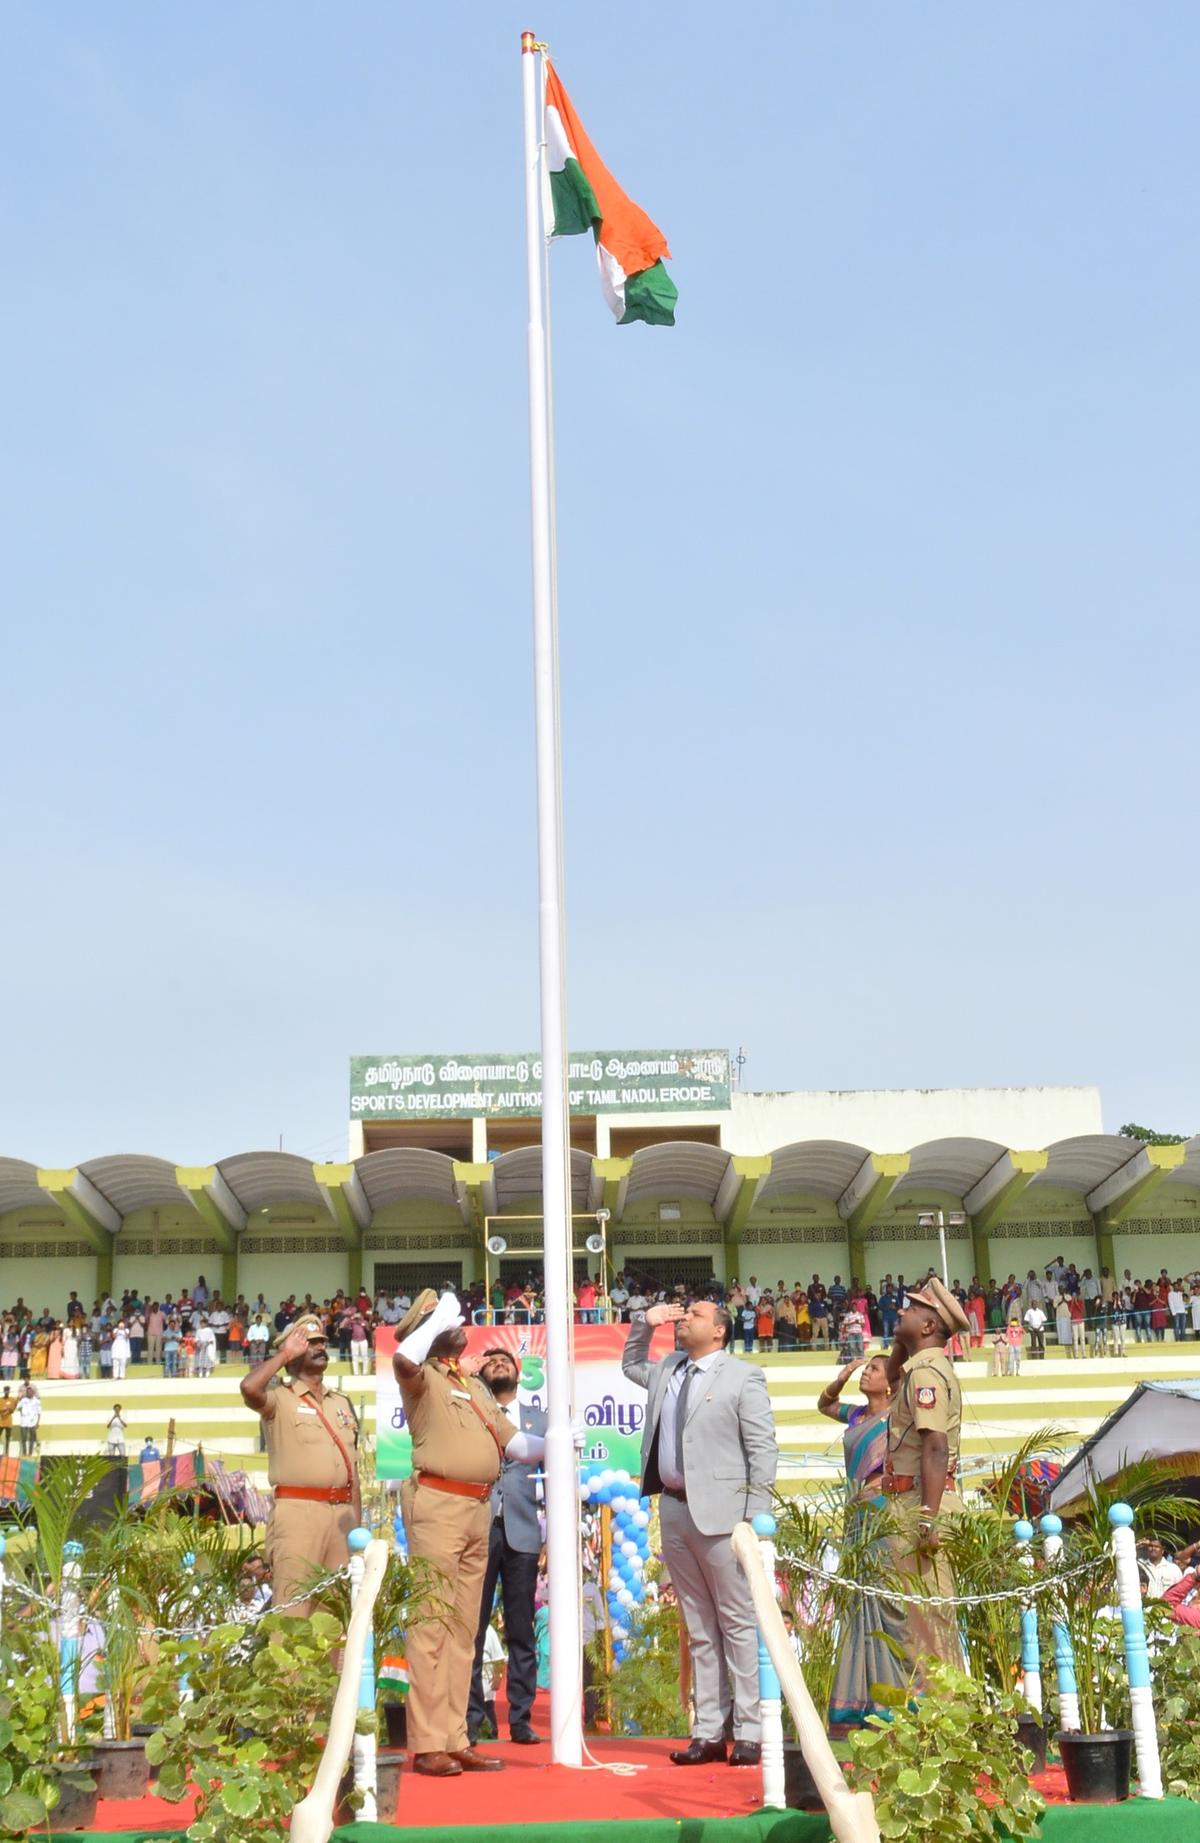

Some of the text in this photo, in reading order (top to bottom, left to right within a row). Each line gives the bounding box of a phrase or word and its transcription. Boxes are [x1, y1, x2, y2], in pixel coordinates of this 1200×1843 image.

[365, 1061, 435, 1090] தமிழ்நாடு
[438, 1060, 529, 1082] விளையாட்டு
[606, 1055, 679, 1078] ஆணையம்
[351, 1093, 405, 1111] SPORTS
[408, 1091, 494, 1109] DEVELOPMENT
[497, 1090, 542, 1107] AUTHO
[569, 1091, 583, 1105] OF
[587, 1090, 621, 1105] TAMIL
[584, 1394, 648, 1436] விழ
